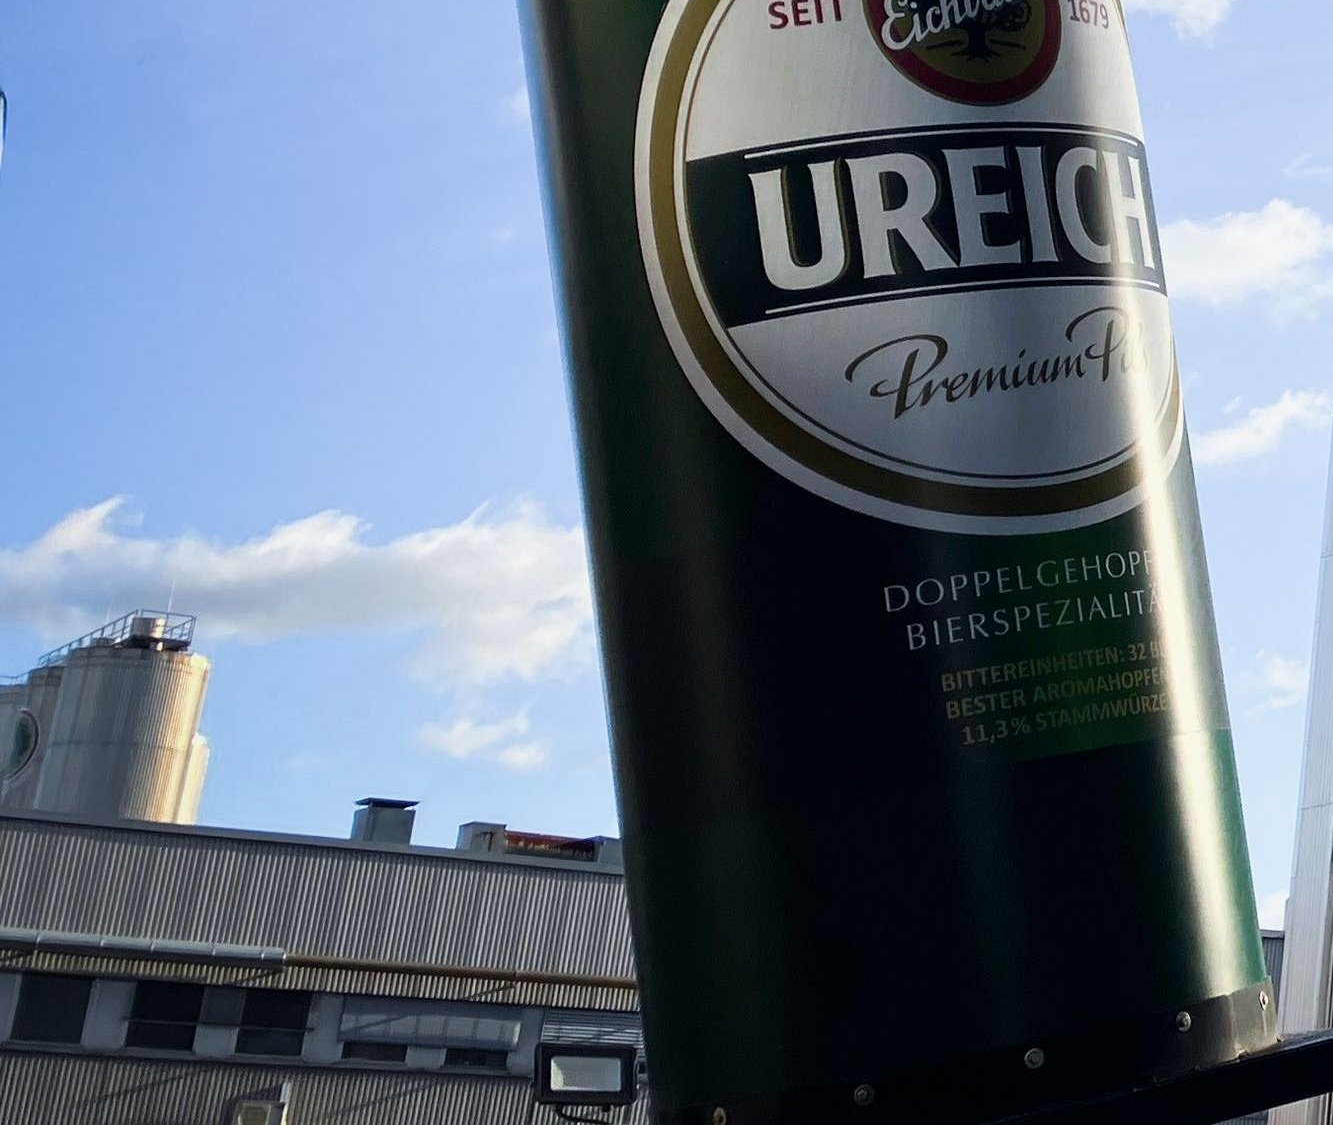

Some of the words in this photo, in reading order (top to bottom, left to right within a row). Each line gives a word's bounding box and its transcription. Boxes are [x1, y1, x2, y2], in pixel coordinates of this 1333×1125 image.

[747, 143, 1157, 291] UREICH
[845, 334, 1086, 421] Premium
[940, 646, 1124, 693] BITTEREINHEITEN:
[1127, 642, 1148, 662] 32
[945, 688, 1027, 720] BESTER
